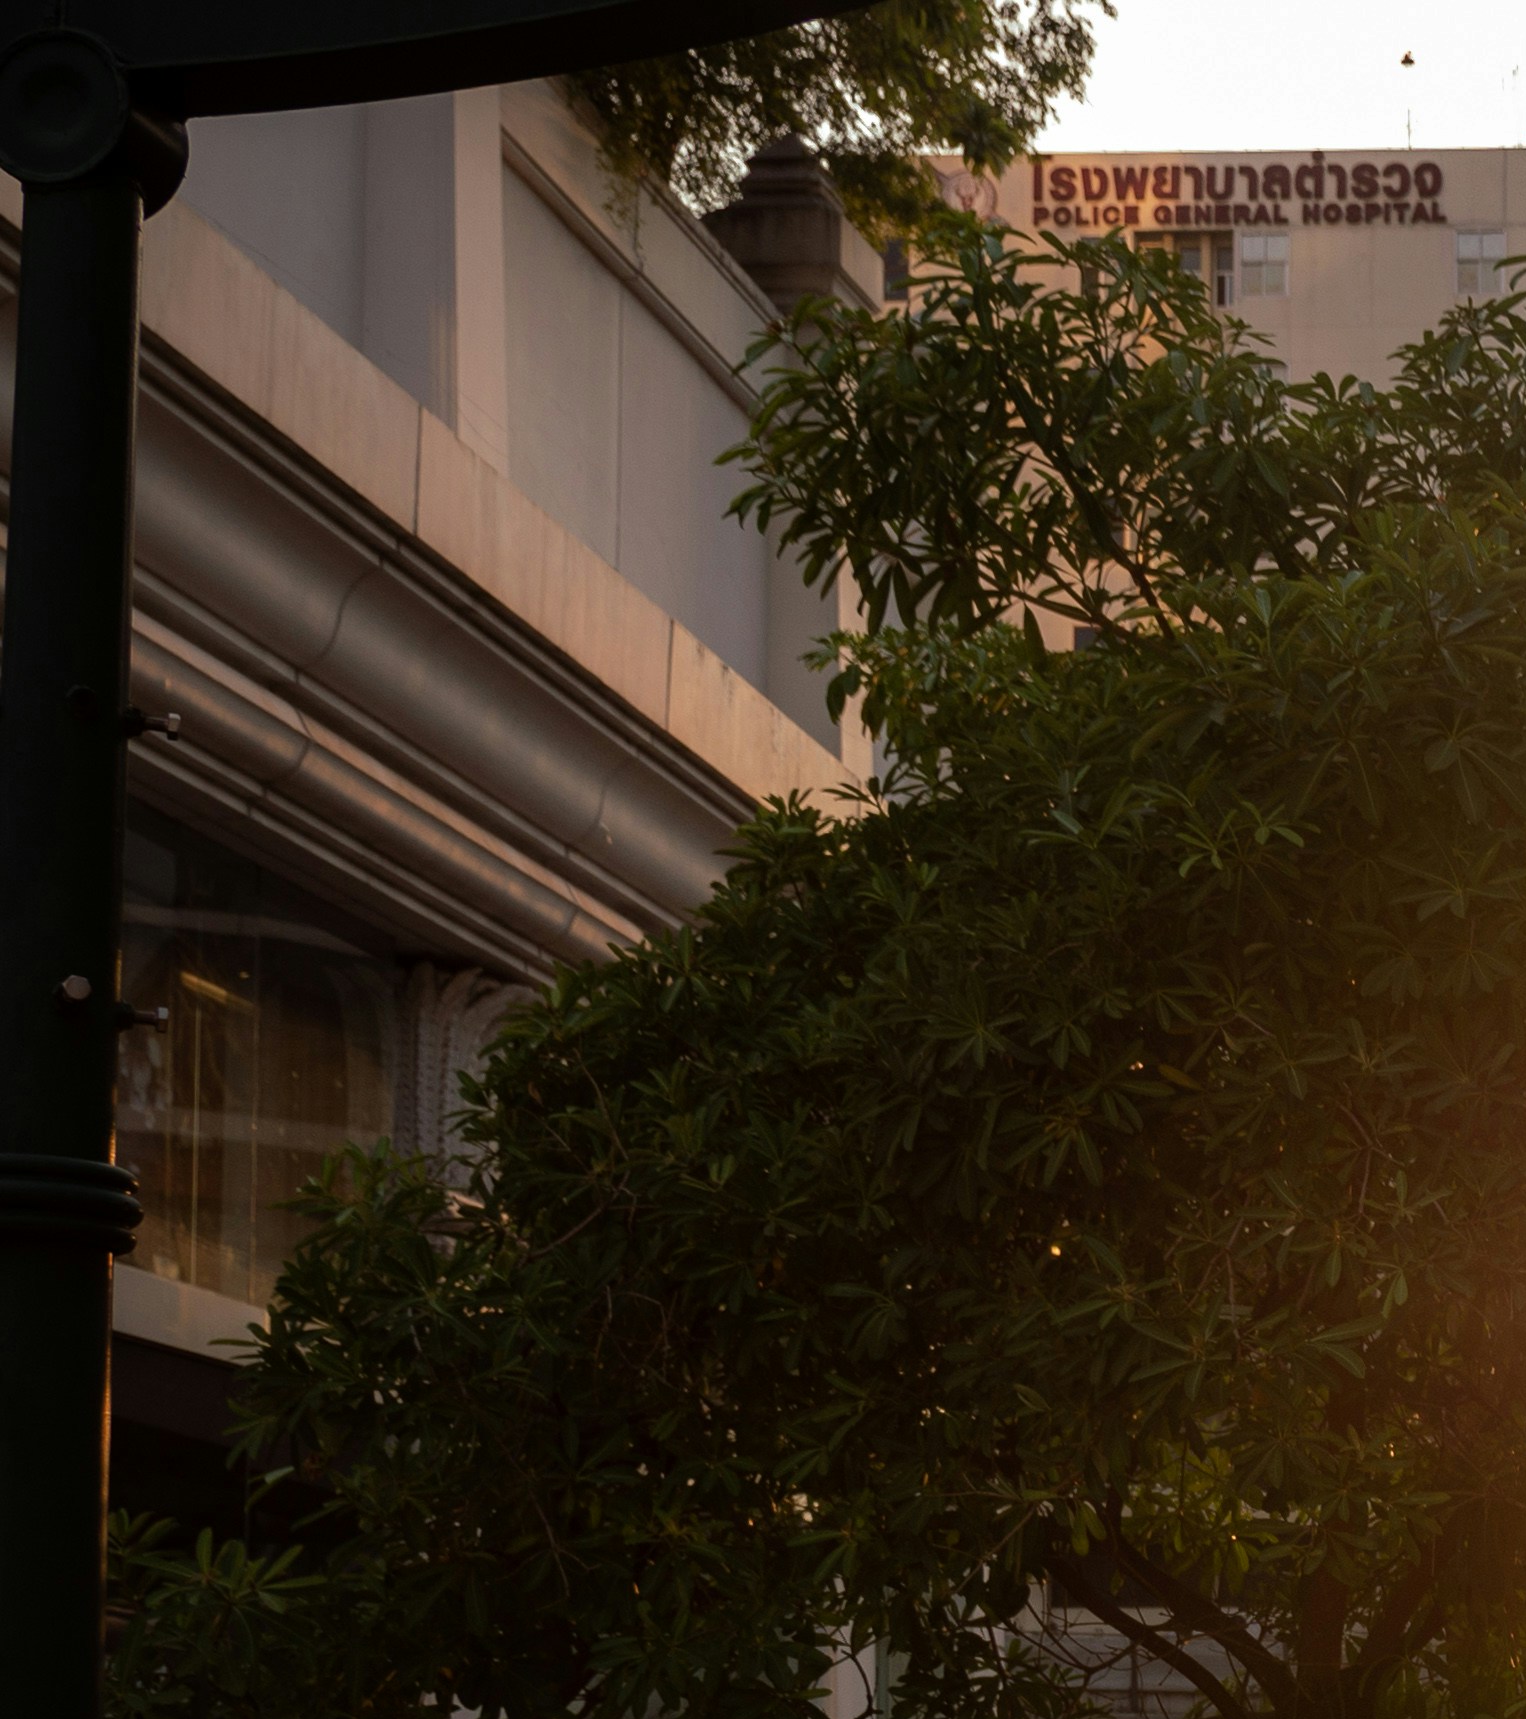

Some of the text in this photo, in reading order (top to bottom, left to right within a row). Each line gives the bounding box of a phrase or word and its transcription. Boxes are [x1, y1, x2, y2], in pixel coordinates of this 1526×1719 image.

[1033, 151, 1443, 202] โรงพยาบาลตำรวจ
[1033, 201, 1447, 226] POLICE GENERAL HOSPITAL
